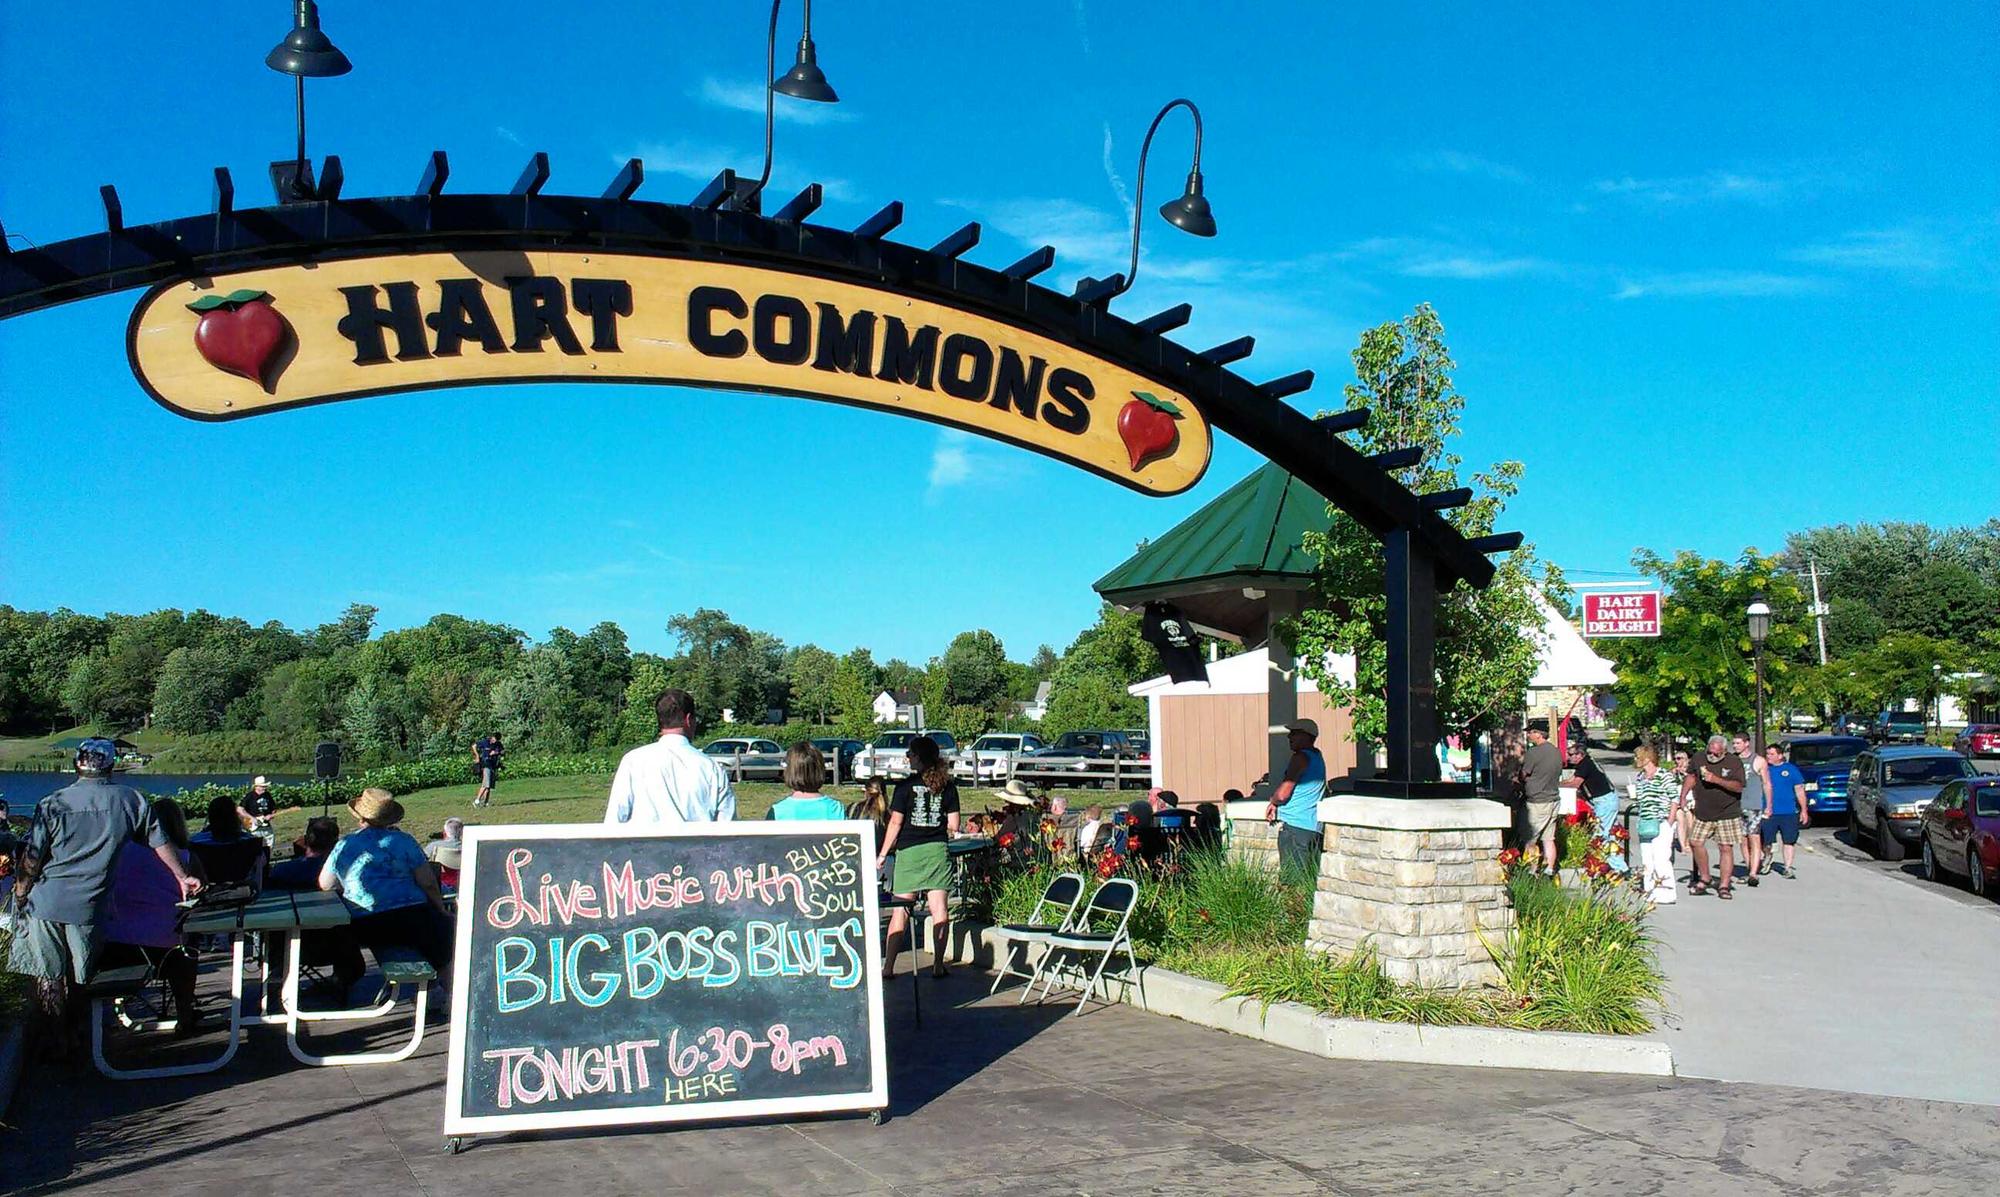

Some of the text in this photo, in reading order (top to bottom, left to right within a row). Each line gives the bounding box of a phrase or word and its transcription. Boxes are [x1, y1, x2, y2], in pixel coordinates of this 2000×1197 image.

[336, 275, 1096, 435] HART COMMONS
[1597, 608, 1645, 620] DAIRY
[1598, 596, 1644, 608] HART
[1588, 621, 1655, 632] DELIGHT
[785, 837, 859, 872] BLUES
[804, 890, 864, 919] SOUL
[496, 917, 863, 1013] BIG BOSS BLUES
[483, 1038, 660, 1108] TONIGHT
[663, 1072, 738, 1102] HERE
